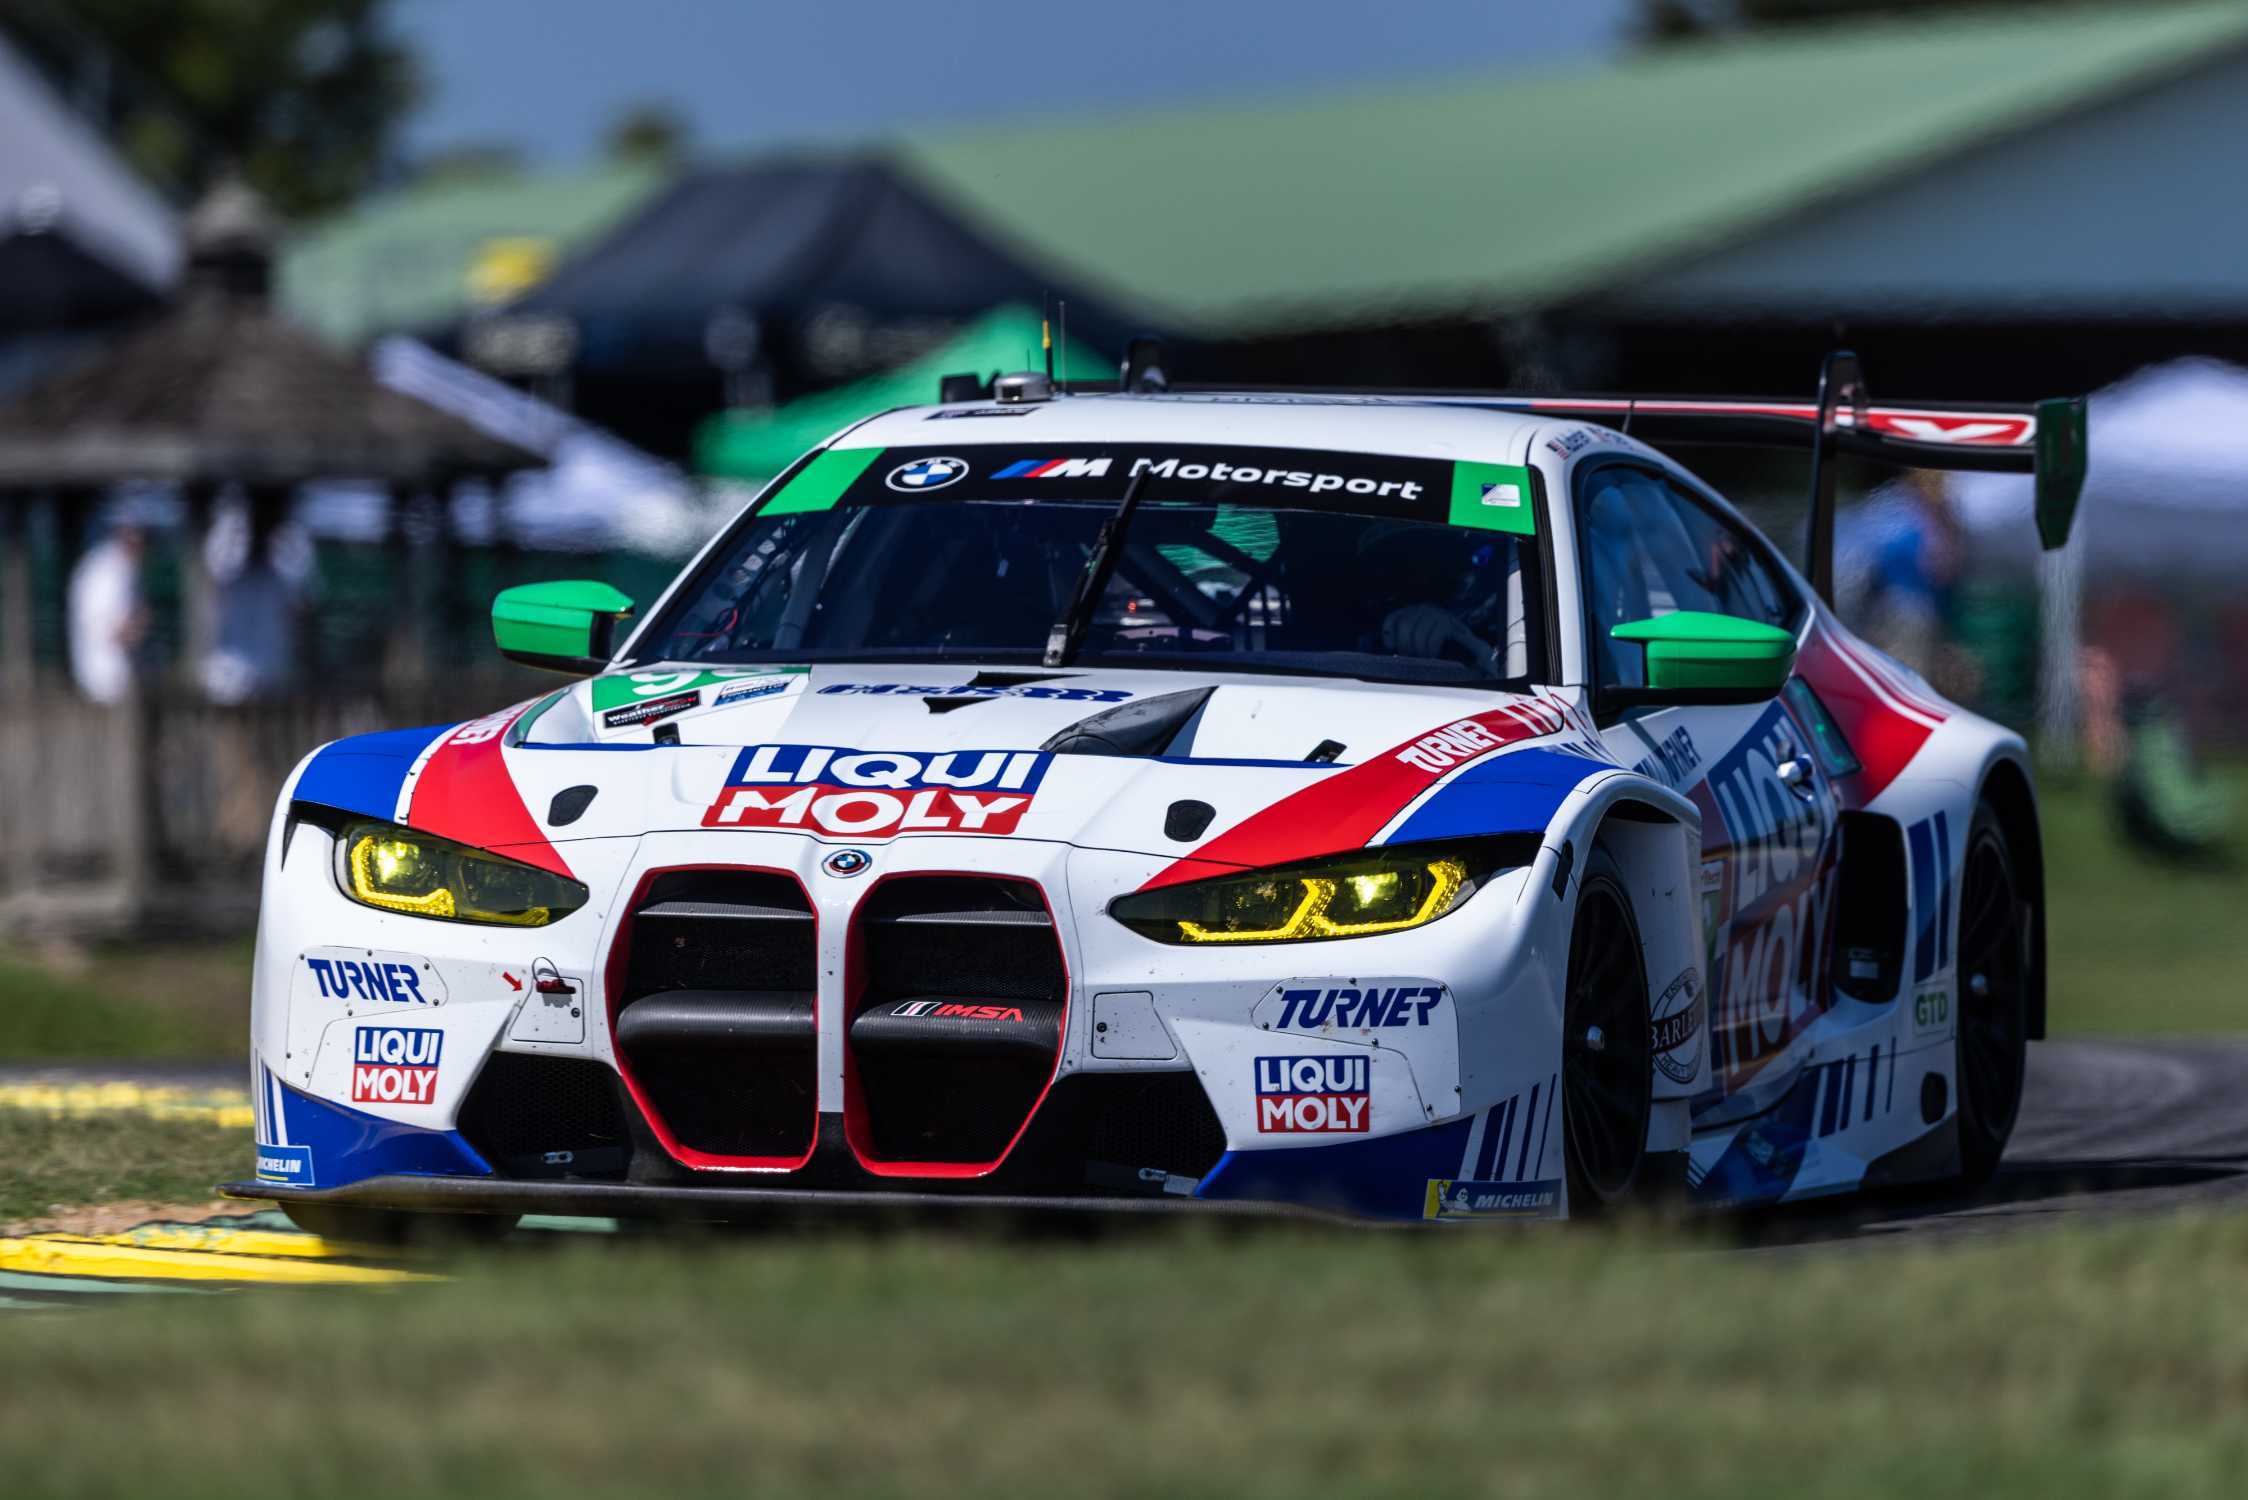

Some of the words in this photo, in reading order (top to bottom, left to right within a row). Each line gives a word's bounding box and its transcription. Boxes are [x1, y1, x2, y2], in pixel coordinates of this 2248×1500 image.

[1128, 458, 1424, 500] Motorsport
[1395, 719, 1504, 774] TURNER
[742, 746, 1038, 789] LIQUI
[716, 789, 1029, 834] MOLY
[307, 958, 428, 1005] TURNER
[933, 1004, 1024, 1023] IMSA
[1275, 987, 1444, 1029] TURNER
[1915, 991, 1948, 1027] GTD
[357, 1030, 441, 1066] LIQUI
[355, 1066, 437, 1101] MOLY
[1259, 1058, 1367, 1095] LIQUI
[1261, 1096, 1369, 1131] MOLY
[1474, 1191, 1554, 1209] MICHELIN
